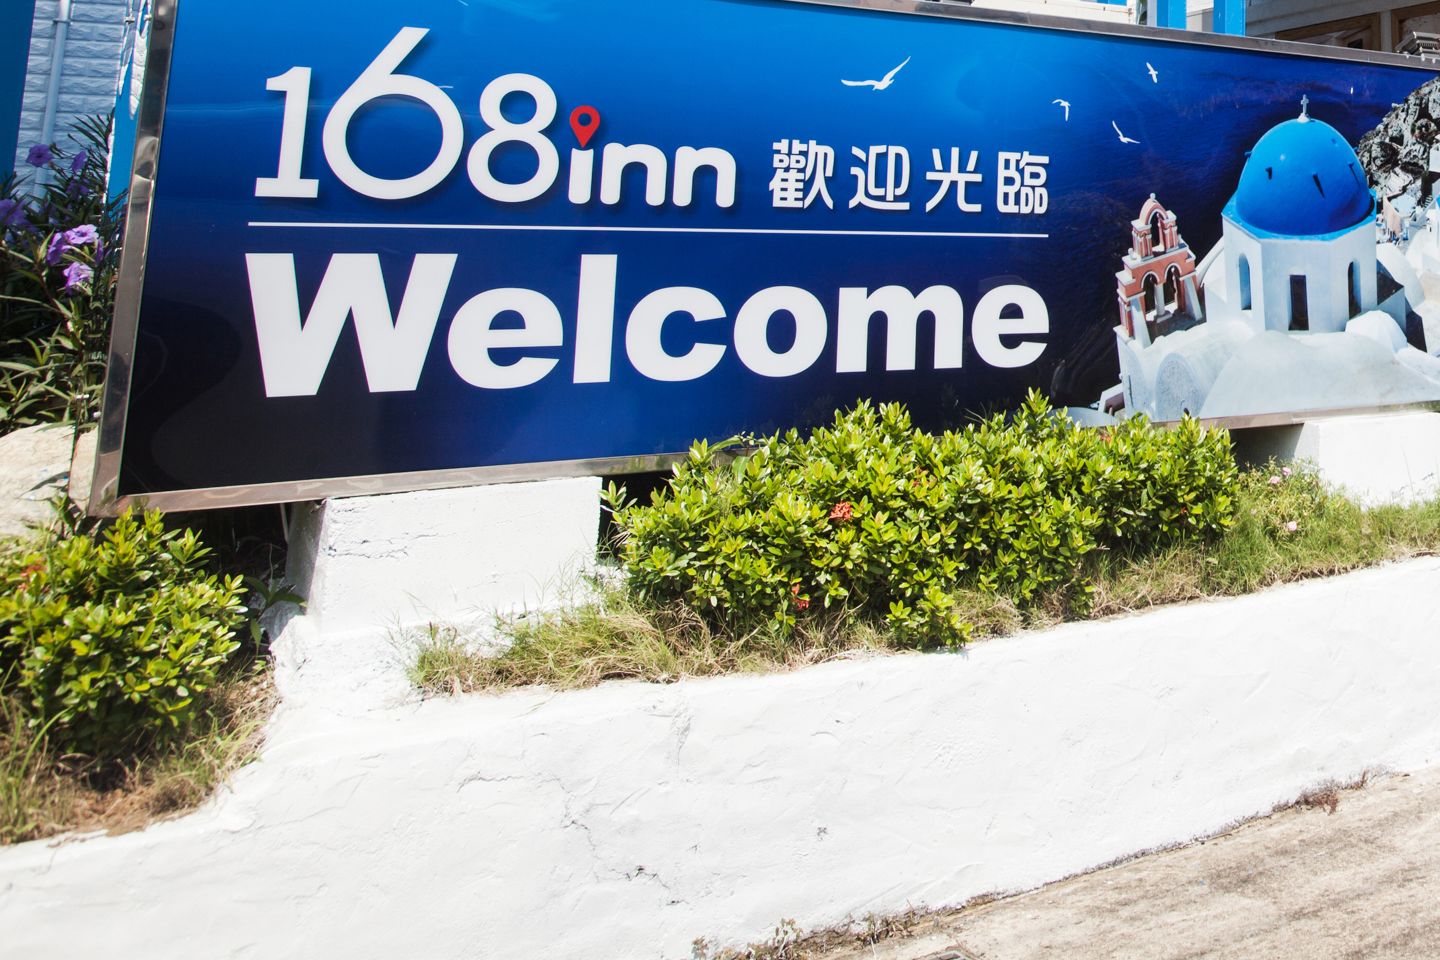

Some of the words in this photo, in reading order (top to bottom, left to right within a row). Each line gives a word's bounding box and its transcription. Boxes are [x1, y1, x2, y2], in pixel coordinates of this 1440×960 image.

[768, 138, 1050, 215] 歡迎光臨
[244, 252, 1051, 399] Welcome
